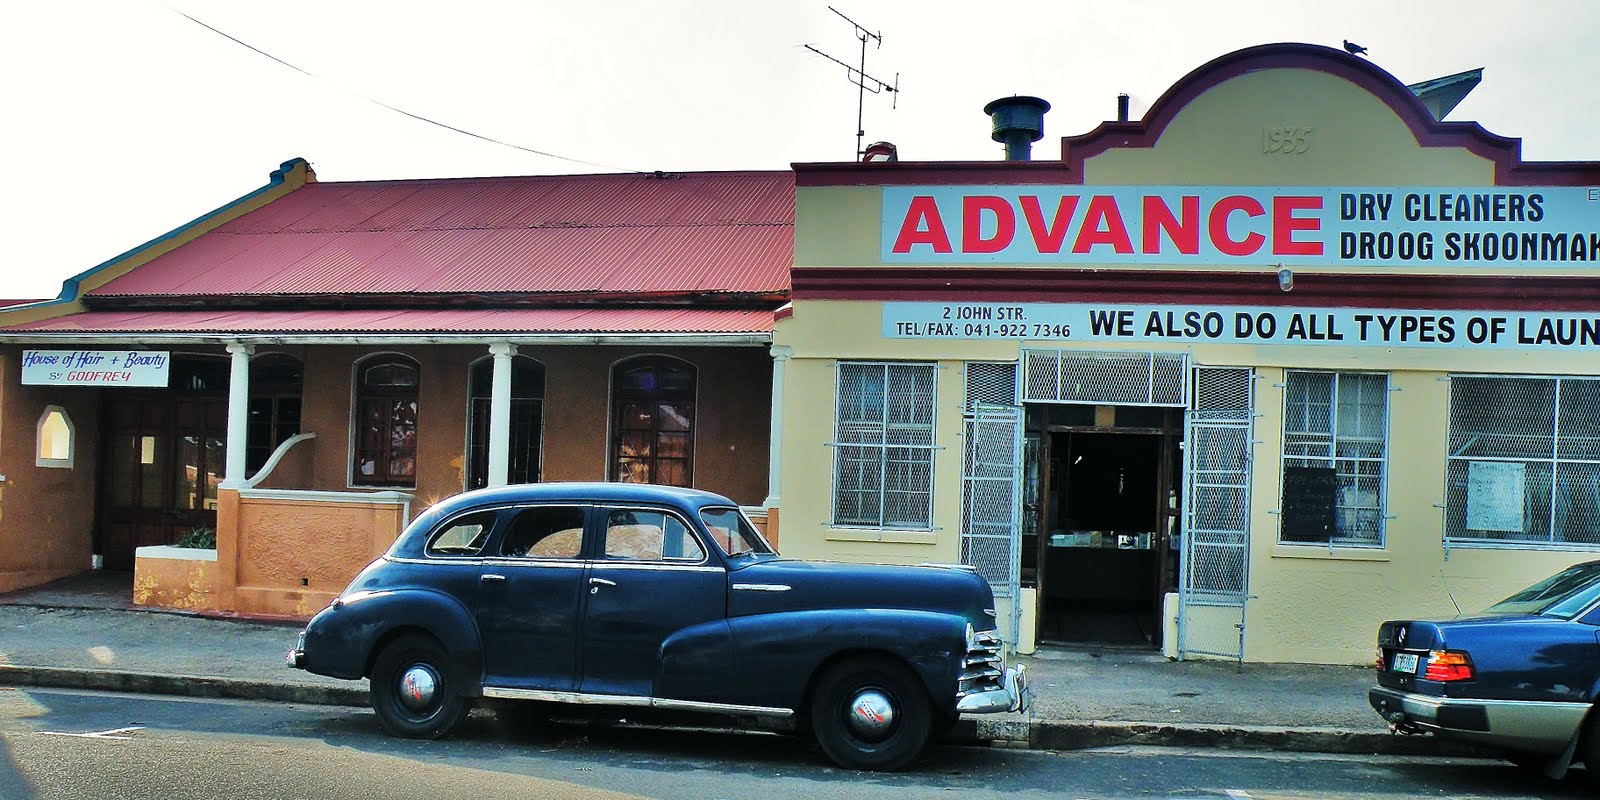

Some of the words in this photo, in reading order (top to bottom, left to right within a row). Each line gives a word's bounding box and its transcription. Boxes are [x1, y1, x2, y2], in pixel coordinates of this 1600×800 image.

[1262, 127, 1312, 154] 1935
[1340, 193, 1393, 221] DRY
[1405, 193, 1544, 222] CLEANERS
[892, 195, 1324, 256] ADVANCE
[1340, 231, 1433, 260] DROOG
[1445, 232, 1600, 261] SKOONMAK
[943, 307, 951, 320] 2
[956, 307, 992, 320] JOHN
[997, 307, 1028, 320] STR.
[896, 322, 959, 336] TEL/FAX:
[964, 323, 1027, 337] 041-922
[1033, 324, 1071, 337] 7346
[1090, 310, 1134, 336] WE
[1144, 311, 1224, 338] ALSO
[1235, 312, 1276, 339] DO
[1287, 313, 1343, 340] ALL
[1355, 315, 1456, 343] TYPES
[1466, 317, 1507, 343] OF
[1518, 318, 1600, 345] LAUN
[22, 351, 60, 368] House
[62, 352, 77, 368] of
[75, 351, 104, 368] Hair
[123, 351, 167, 369] Beauty
[66, 371, 132, 382] GODFREY
